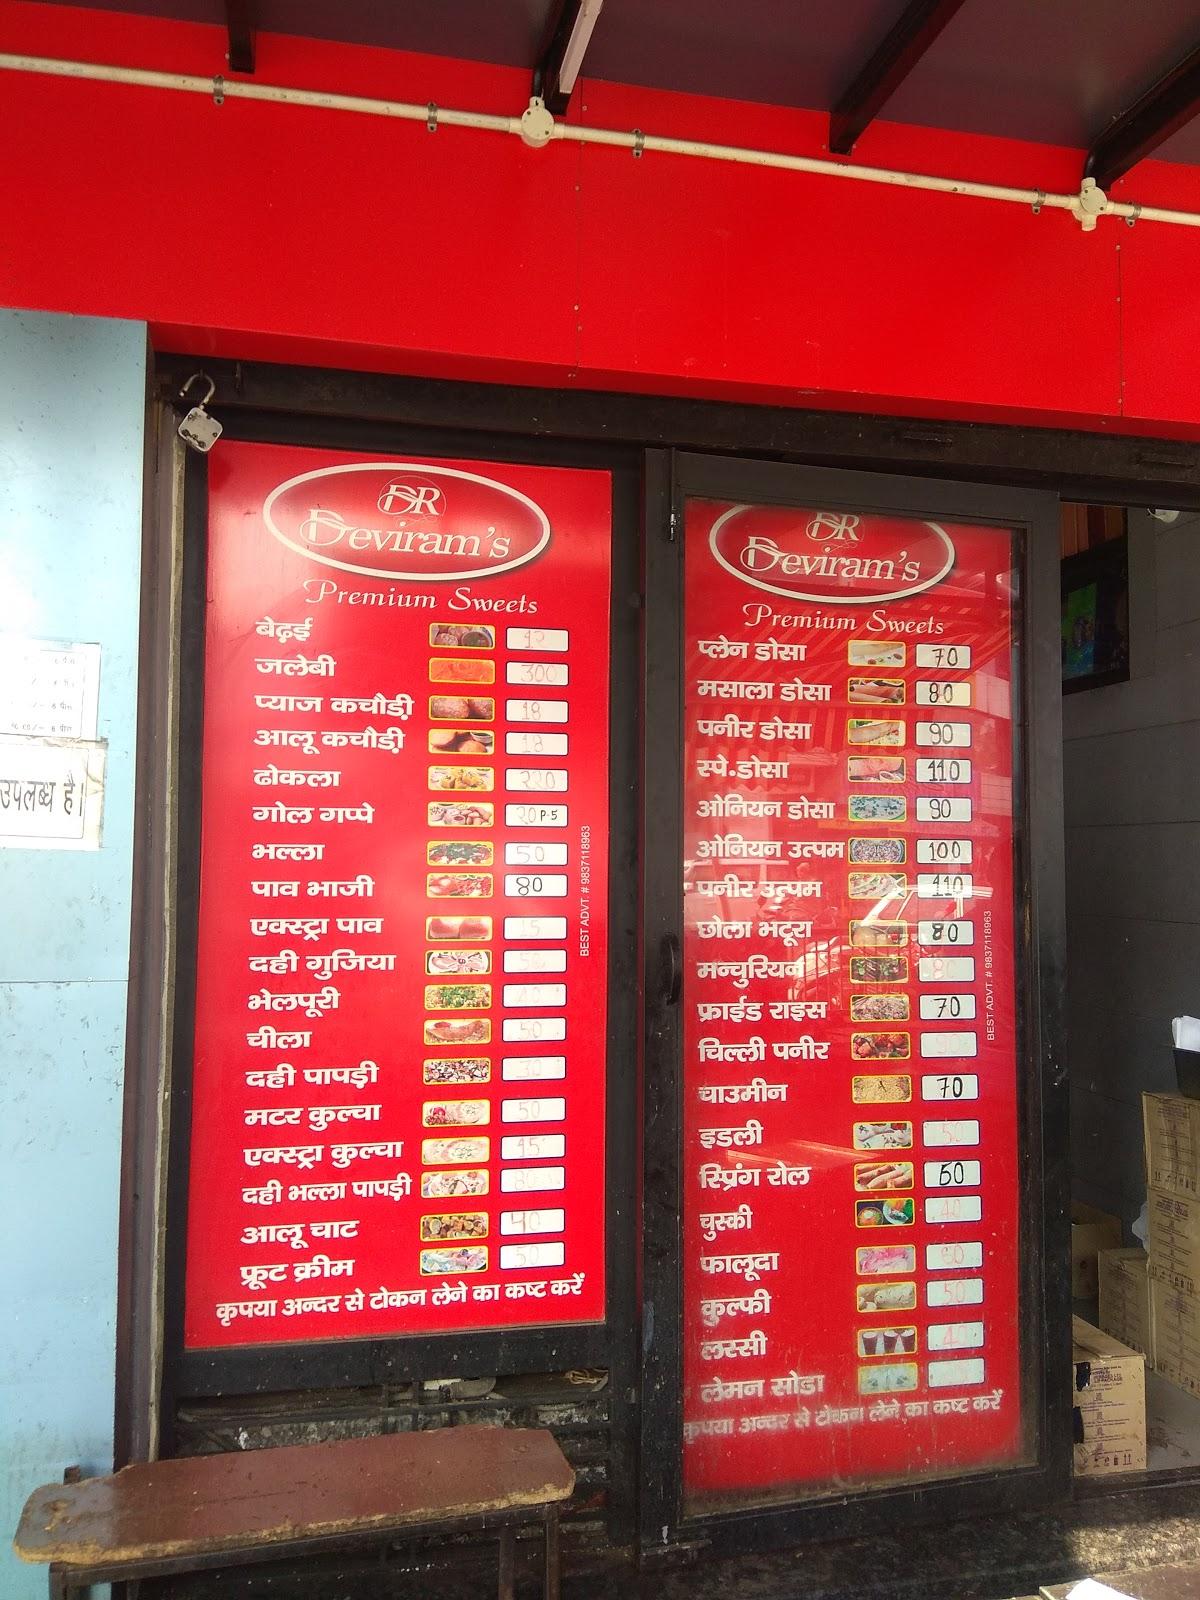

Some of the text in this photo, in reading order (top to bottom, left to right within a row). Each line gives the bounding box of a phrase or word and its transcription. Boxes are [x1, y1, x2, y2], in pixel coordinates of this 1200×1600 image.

[298, 508, 511, 559] Deviram's
[739, 535, 921, 582] Deviram's
[302, 578, 539, 615] Premium Sweets
[741, 602, 945, 635] Premium Sweets
[698, 635, 807, 661] प्लेन डोसा
[931, 647, 958, 668] 70
[254, 654, 337, 676] जलेबी
[697, 677, 832, 701] मसाला डोसा
[928, 683, 954, 704] 80
[254, 695, 324, 712] प्याज
[522, 701, 541, 721] 18
[697, 714, 812, 740] पनीर डोसा
[928, 723, 954, 745] 90
[253, 730, 320, 754] आलू
[253, 764, 341, 787] ढोकला
[927, 759, 960, 782] 110
[252, 801, 375, 824] गोल गप्पे
[696, 793, 836, 820] ओनियन डोसा
[929, 798, 952, 819] 90
[252, 844, 325, 861] भल्ला
[516, 845, 545, 863] 50
[580, 825, 590, 885] 9837118963
[696, 833, 845, 858] ओनियन उत्पम
[928, 840, 961, 862] 100
[251, 875, 375, 897] पाव भाजी
[516, 876, 543, 896] 80
[581, 886, 590, 894] #
[696, 875, 756, 898] पनीर
[250, 918, 384, 941] एक्स्ट्रा पाव
[579, 928, 589, 957] BEST
[697, 918, 813, 947] छोला भटूरा
[931, 923, 958, 942] 80
[983, 910, 993, 969] 9837118963
[249, 951, 397, 980] दही गुजिया
[248, 986, 341, 1018] भेलपूरी
[769, 1002, 828, 1022] राइस
[933, 996, 961, 1017] 70
[246, 1026, 312, 1049] चीला
[986, 1012, 995, 1041] BEST
[697, 1035, 831, 1062] चिल्ली पनीर
[245, 1060, 380, 1089] दही पापड़ी
[936, 1076, 963, 1098] 70
[698, 1077, 788, 1103] चाउमीन
[244, 1104, 382, 1131] मटर कुल्चा
[518, 1100, 541, 1121] 50
[699, 1119, 764, 1149] इडली
[243, 1141, 404, 1169] एक्स्ट्रा कुल्चा
[766, 1162, 812, 1185] रोल
[242, 1172, 412, 1205] दही भल्ला पापड़ी
[240, 1220, 360, 1249] आलू चाट
[511, 1211, 541, 1233] 40
[699, 1204, 753, 1241] चुस्की
[240, 1254, 355, 1290] फ्रूट क्रीम
[700, 1253, 780, 1281] फालूदा
[216, 1272, 585, 1327] कृपया अन्दर से टोकन लेने का कष्ट करें
[700, 1291, 772, 1327] कुल्फी
[701, 1333, 768, 1360] लस्सी
[701, 1370, 825, 1403] लेमन सोडा
[793, 1406, 812, 1428] से
[814, 1404, 865, 1426] टोकन
[868, 1398, 901, 1422] लेने
[904, 1401, 930, 1417] का
[933, 1397, 970, 1414] कष्ट
[972, 1389, 1003, 1411] करें
